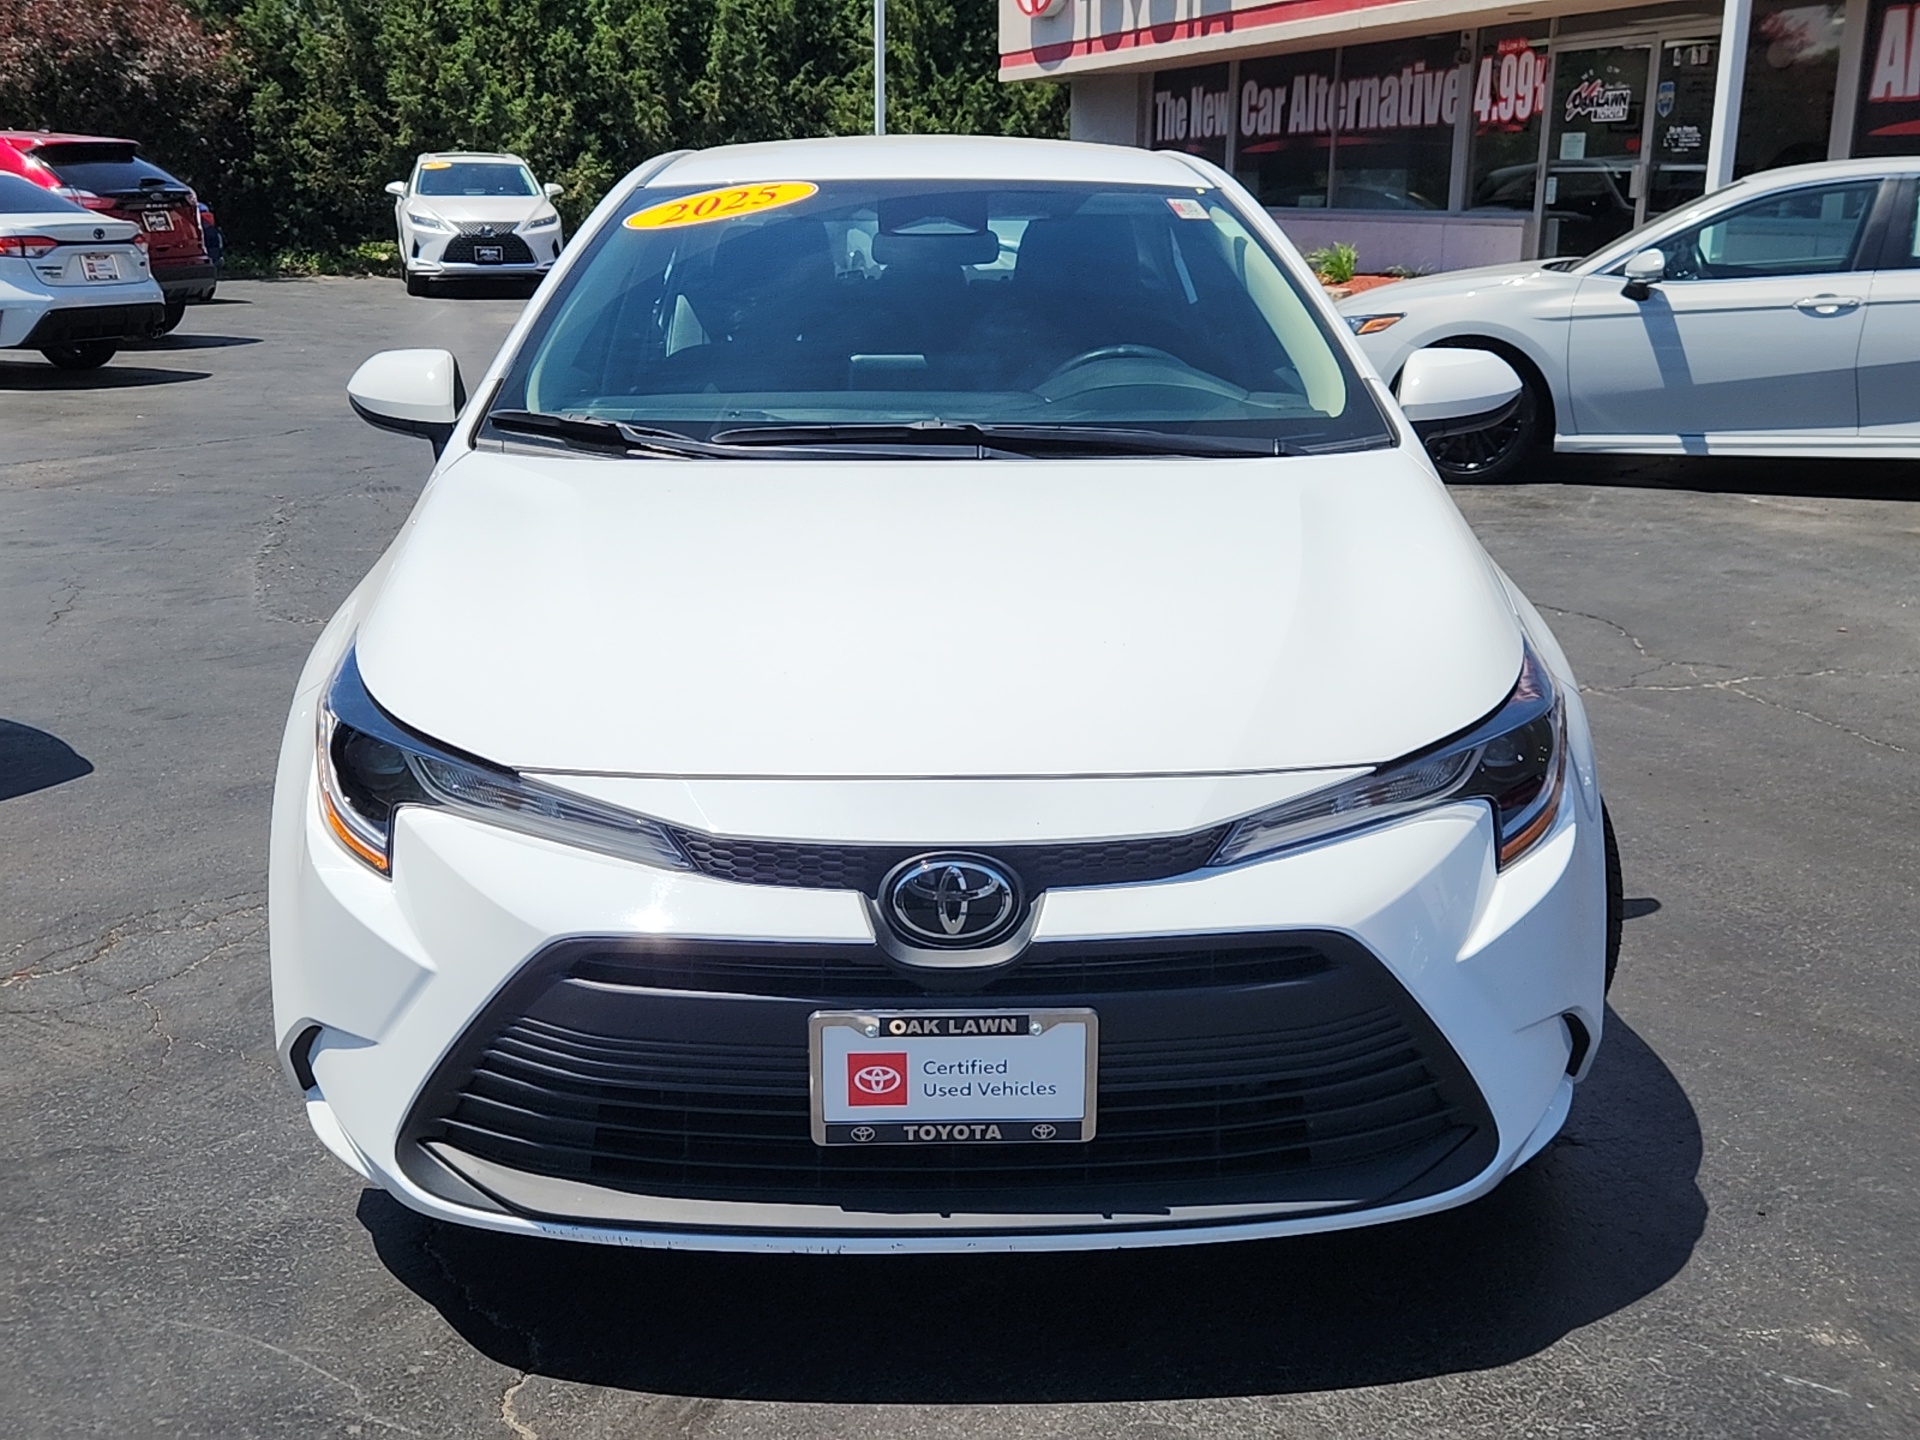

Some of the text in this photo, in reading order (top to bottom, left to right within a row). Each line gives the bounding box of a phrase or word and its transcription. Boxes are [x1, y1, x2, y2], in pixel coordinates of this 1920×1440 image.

[1155, 61, 1460, 141] The New Car Alternative
[659, 185, 782, 225] 2025
[889, 1018, 1017, 1035] OAK LAWN
[923, 1059, 1008, 1076] Certified
[923, 1081, 1057, 1097] Used Vehicles
[903, 1124, 1002, 1141] TOYOTA
